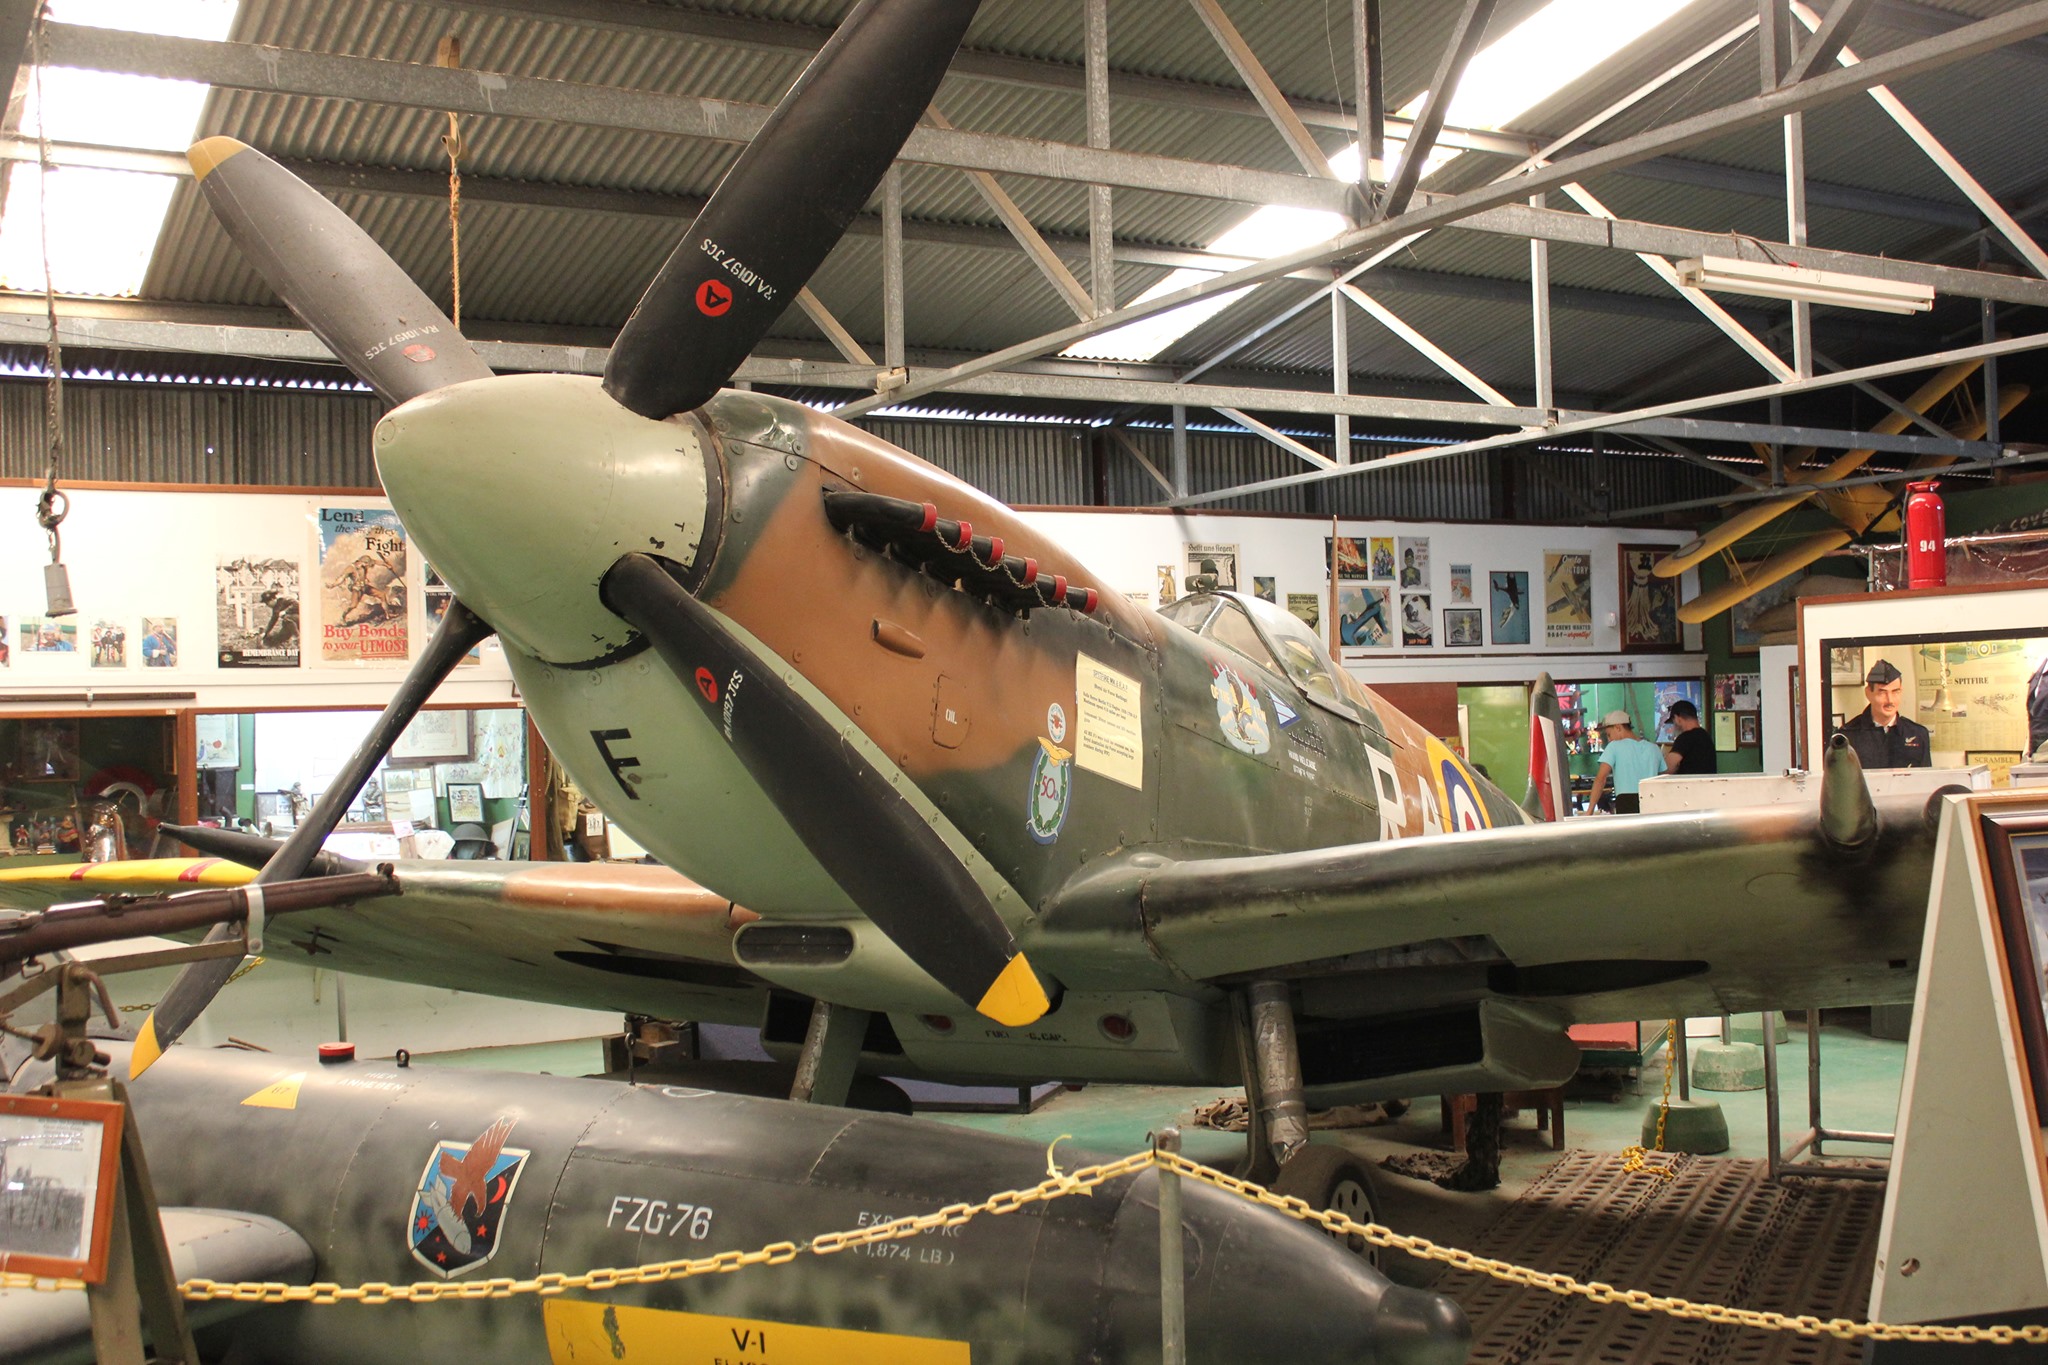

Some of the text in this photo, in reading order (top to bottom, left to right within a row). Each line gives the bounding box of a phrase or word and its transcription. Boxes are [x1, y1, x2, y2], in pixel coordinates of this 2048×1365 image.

[700, 238, 726, 262] JCS
[364, 342, 388, 361] JCS
[321, 508, 366, 524] Lend
[334, 523, 351, 533] the
[374, 526, 396, 537] they
[365, 536, 406, 557] Fight
[1919, 539, 1936, 553] 94
[323, 622, 406, 641] Buy Bonds
[322, 639, 407, 653] to your UTMOST
[727, 669, 743, 697] JCS
[1954, 676, 1990, 686] SPITFIRE
[1974, 756, 2015, 764] SCRAMBLE
